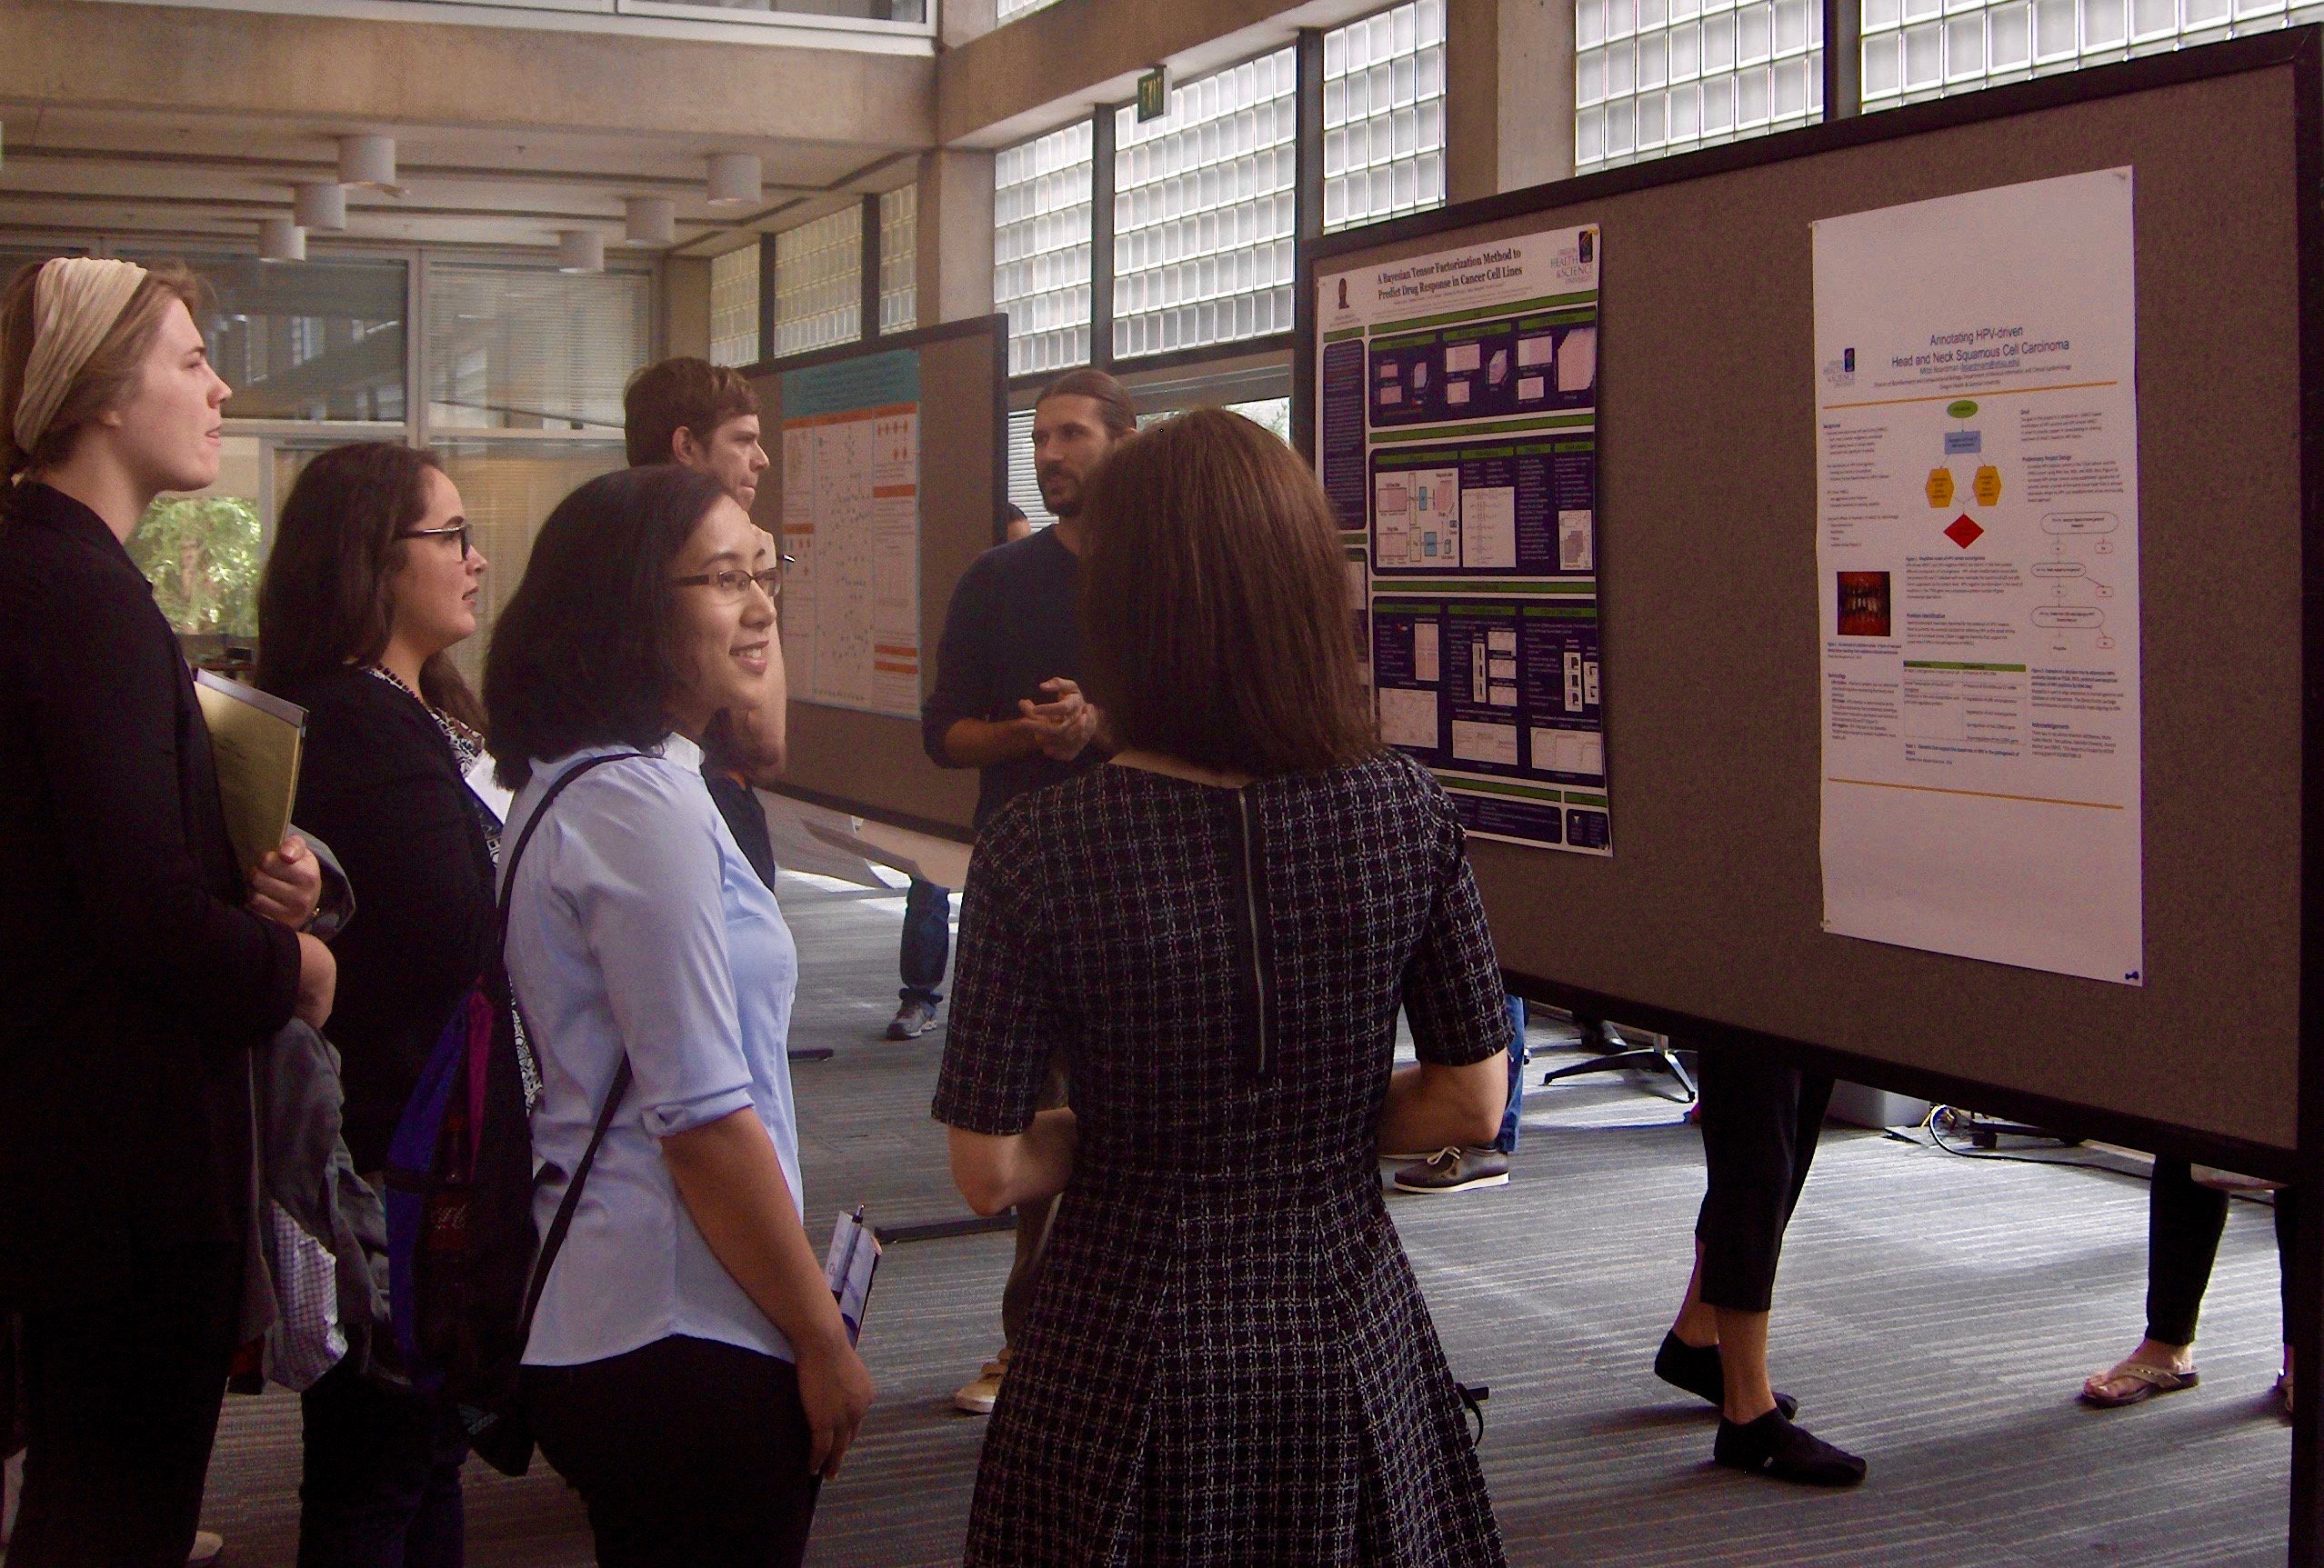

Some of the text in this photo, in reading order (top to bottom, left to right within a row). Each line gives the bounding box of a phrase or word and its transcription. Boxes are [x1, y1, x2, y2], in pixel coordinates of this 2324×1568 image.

[1377, 248, 1522, 285] A Bayesian Tensor Factorization Method to
[1377, 286, 1401, 300] Predict
[1402, 285, 1419, 297] Drug
[1419, 279, 1451, 294] Response
[1452, 275, 1459, 286] in
[1460, 272, 1486, 285] Cancer
[1487, 267, 1501, 281] Cell
[1502, 265, 1523, 278] Lines
[1929, 326, 2024, 345] Annotating HPV-driven
[1891, 340, 2069, 367] Head and Neck Squamous Cell Carcinoma
